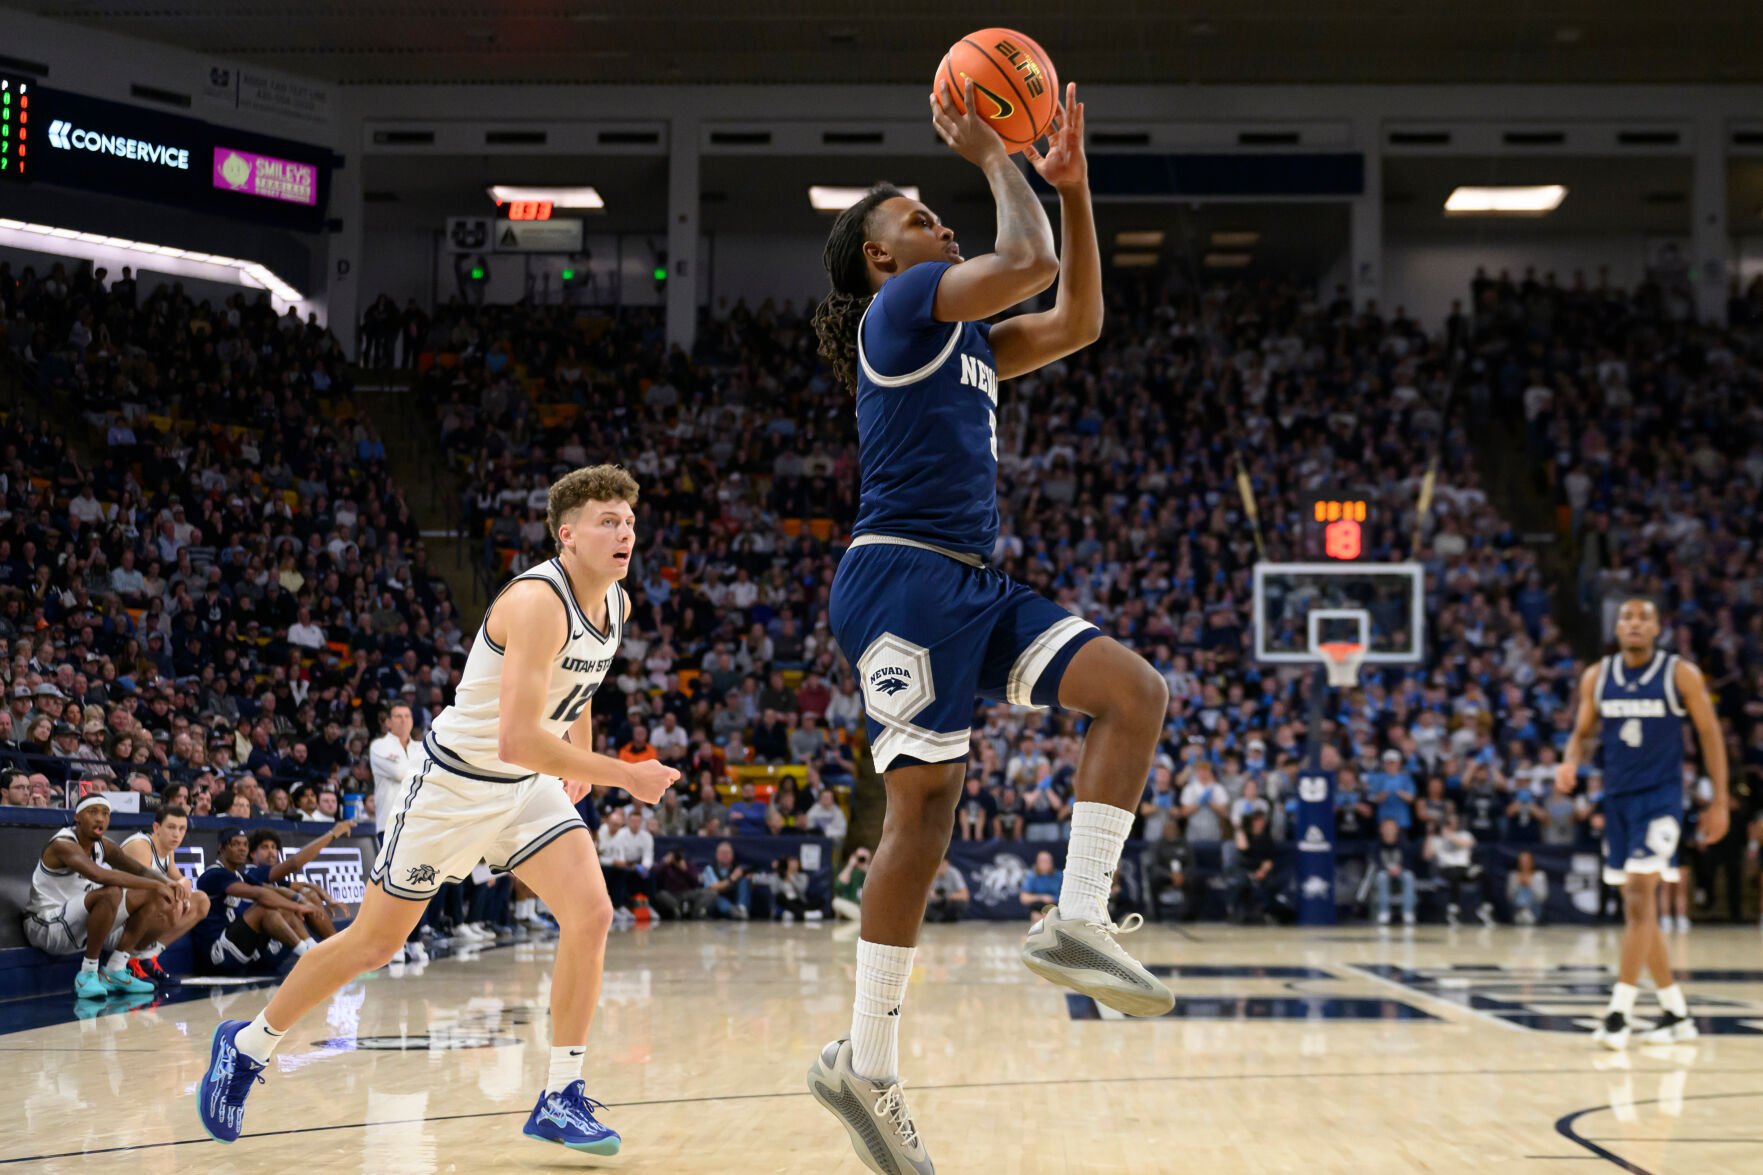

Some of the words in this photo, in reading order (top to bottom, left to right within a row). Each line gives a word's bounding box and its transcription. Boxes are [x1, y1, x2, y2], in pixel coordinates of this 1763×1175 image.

[994, 40, 1044, 99] ELITE
[71, 128, 189, 170] CONSERVICE
[561, 656, 596, 673] UTAH
[870, 667, 912, 684] NEVADA
[550, 682, 600, 722] 12
[1619, 718, 1643, 748] 4
